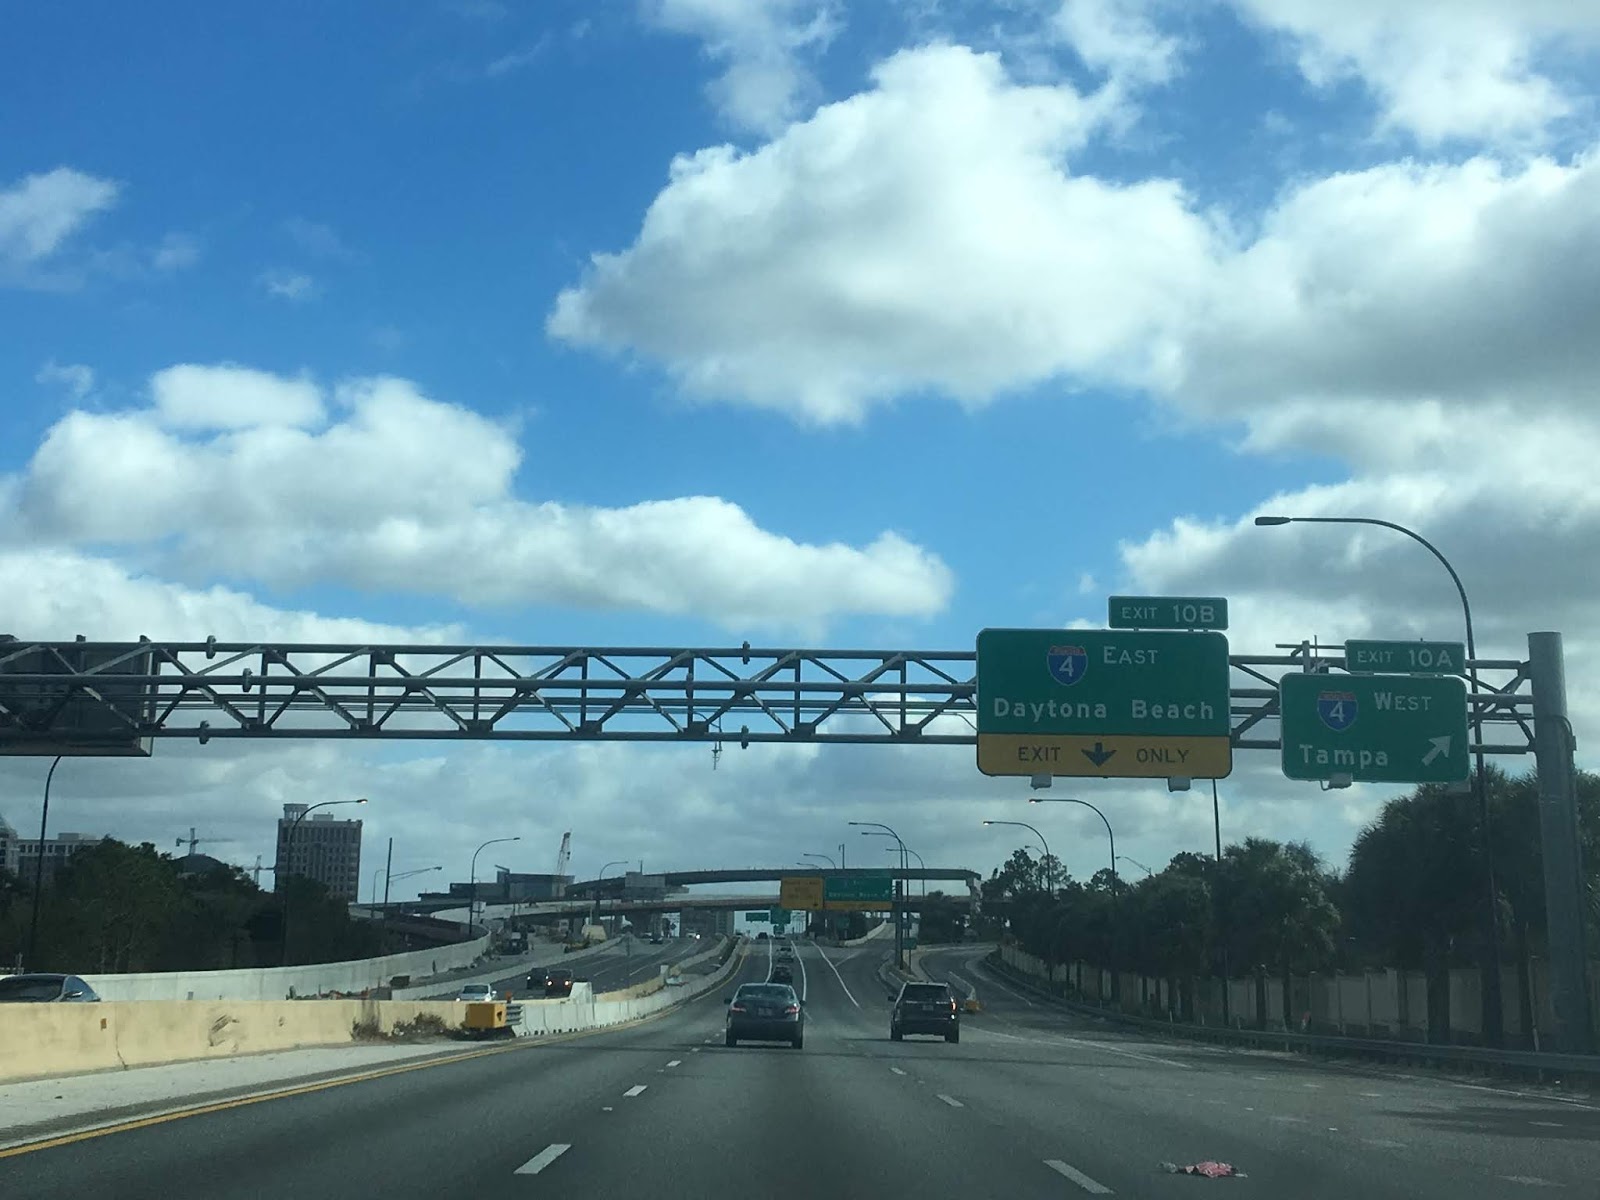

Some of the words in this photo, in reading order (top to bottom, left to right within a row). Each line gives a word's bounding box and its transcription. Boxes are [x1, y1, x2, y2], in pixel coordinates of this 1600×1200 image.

[1121, 606, 1157, 619] EXIT
[1172, 604, 1215, 623] 10B
[1103, 646, 1158, 665] EAST
[1356, 650, 1394, 663] EXIT
[1408, 649, 1453, 668] 10A
[1058, 655, 1074, 677] 4
[993, 697, 1108, 722] Daytona
[1131, 699, 1214, 720] Beach
[1374, 691, 1432, 711] WEST
[1329, 700, 1344, 723] 4
[1018, 746, 1061, 762] EXIT
[1136, 748, 1190, 763] ONLY
[1299, 743, 1389, 770] Tampa
